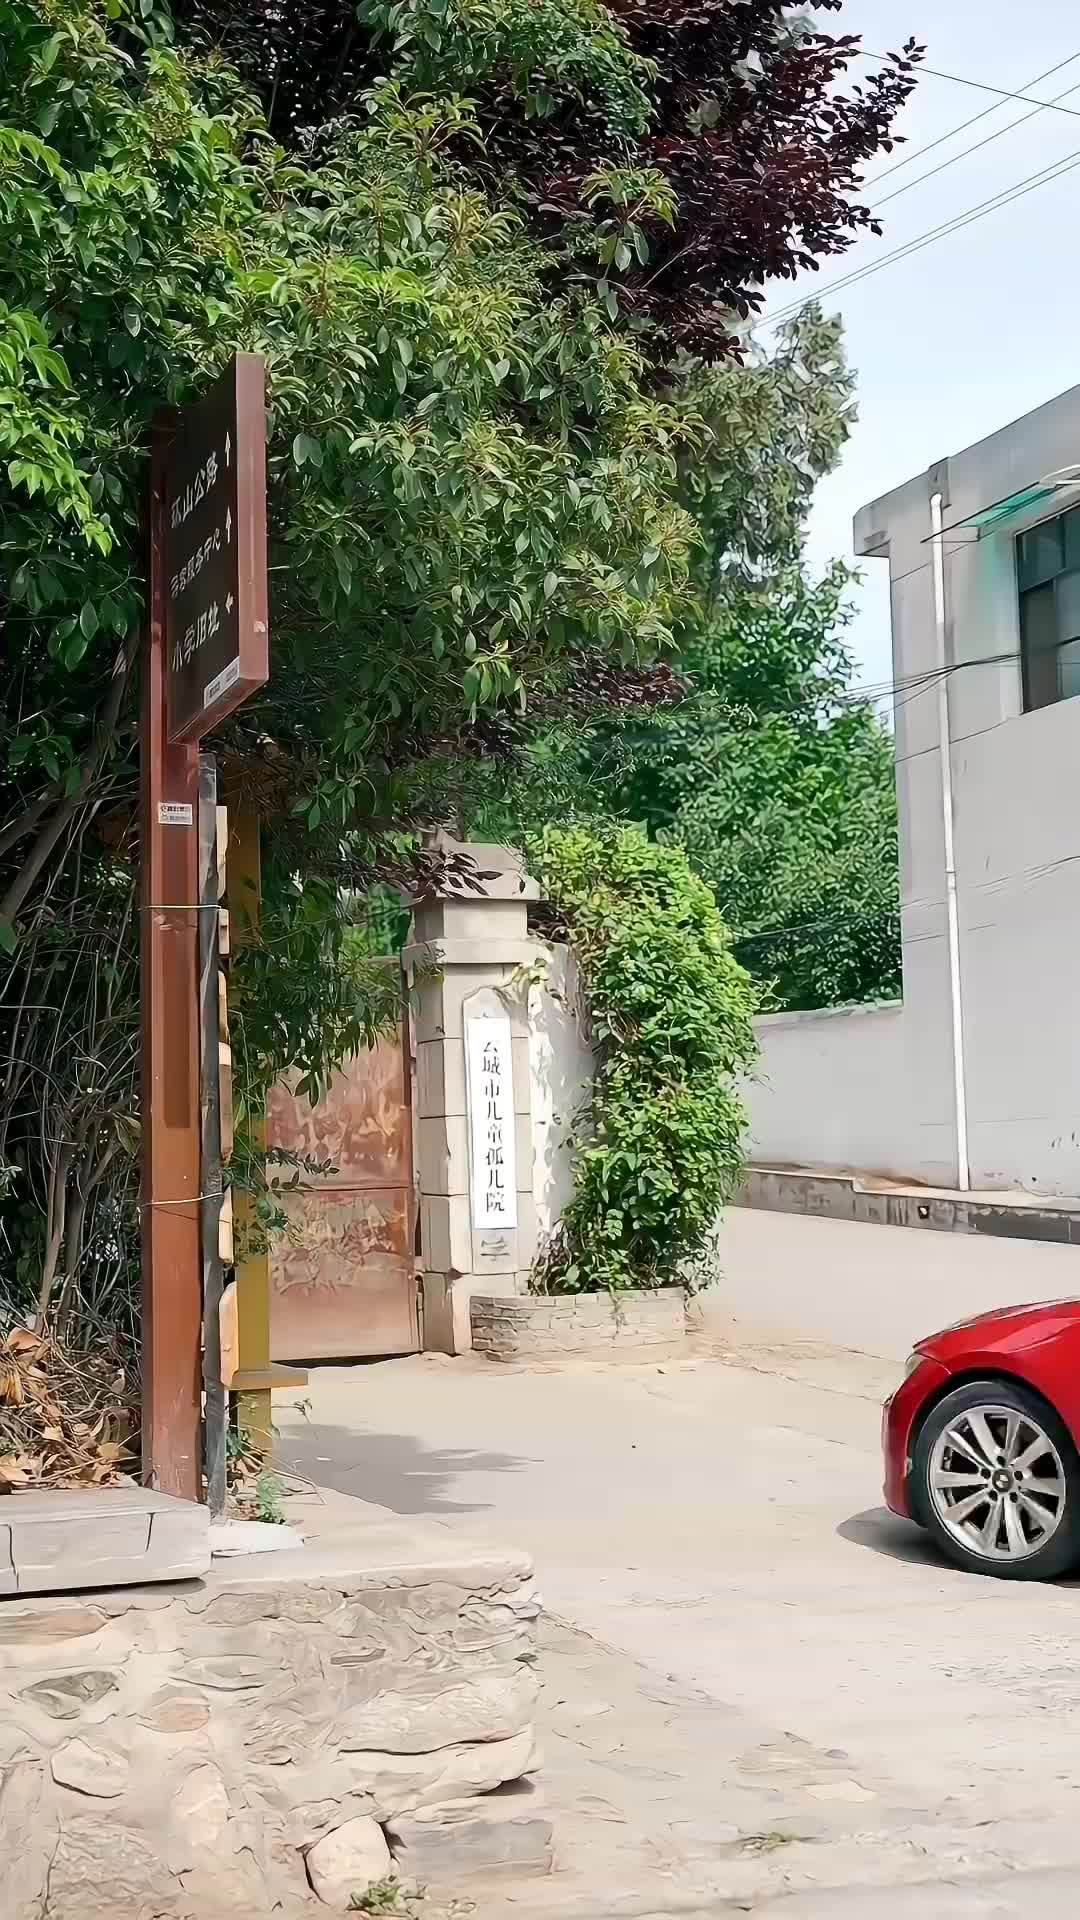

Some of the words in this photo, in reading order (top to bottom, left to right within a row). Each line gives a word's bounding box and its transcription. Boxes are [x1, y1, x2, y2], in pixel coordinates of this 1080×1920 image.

[172, 601, 220, 673] 小学旧址
[482, 1041, 505, 1213] 云城市儿童孤儿院
